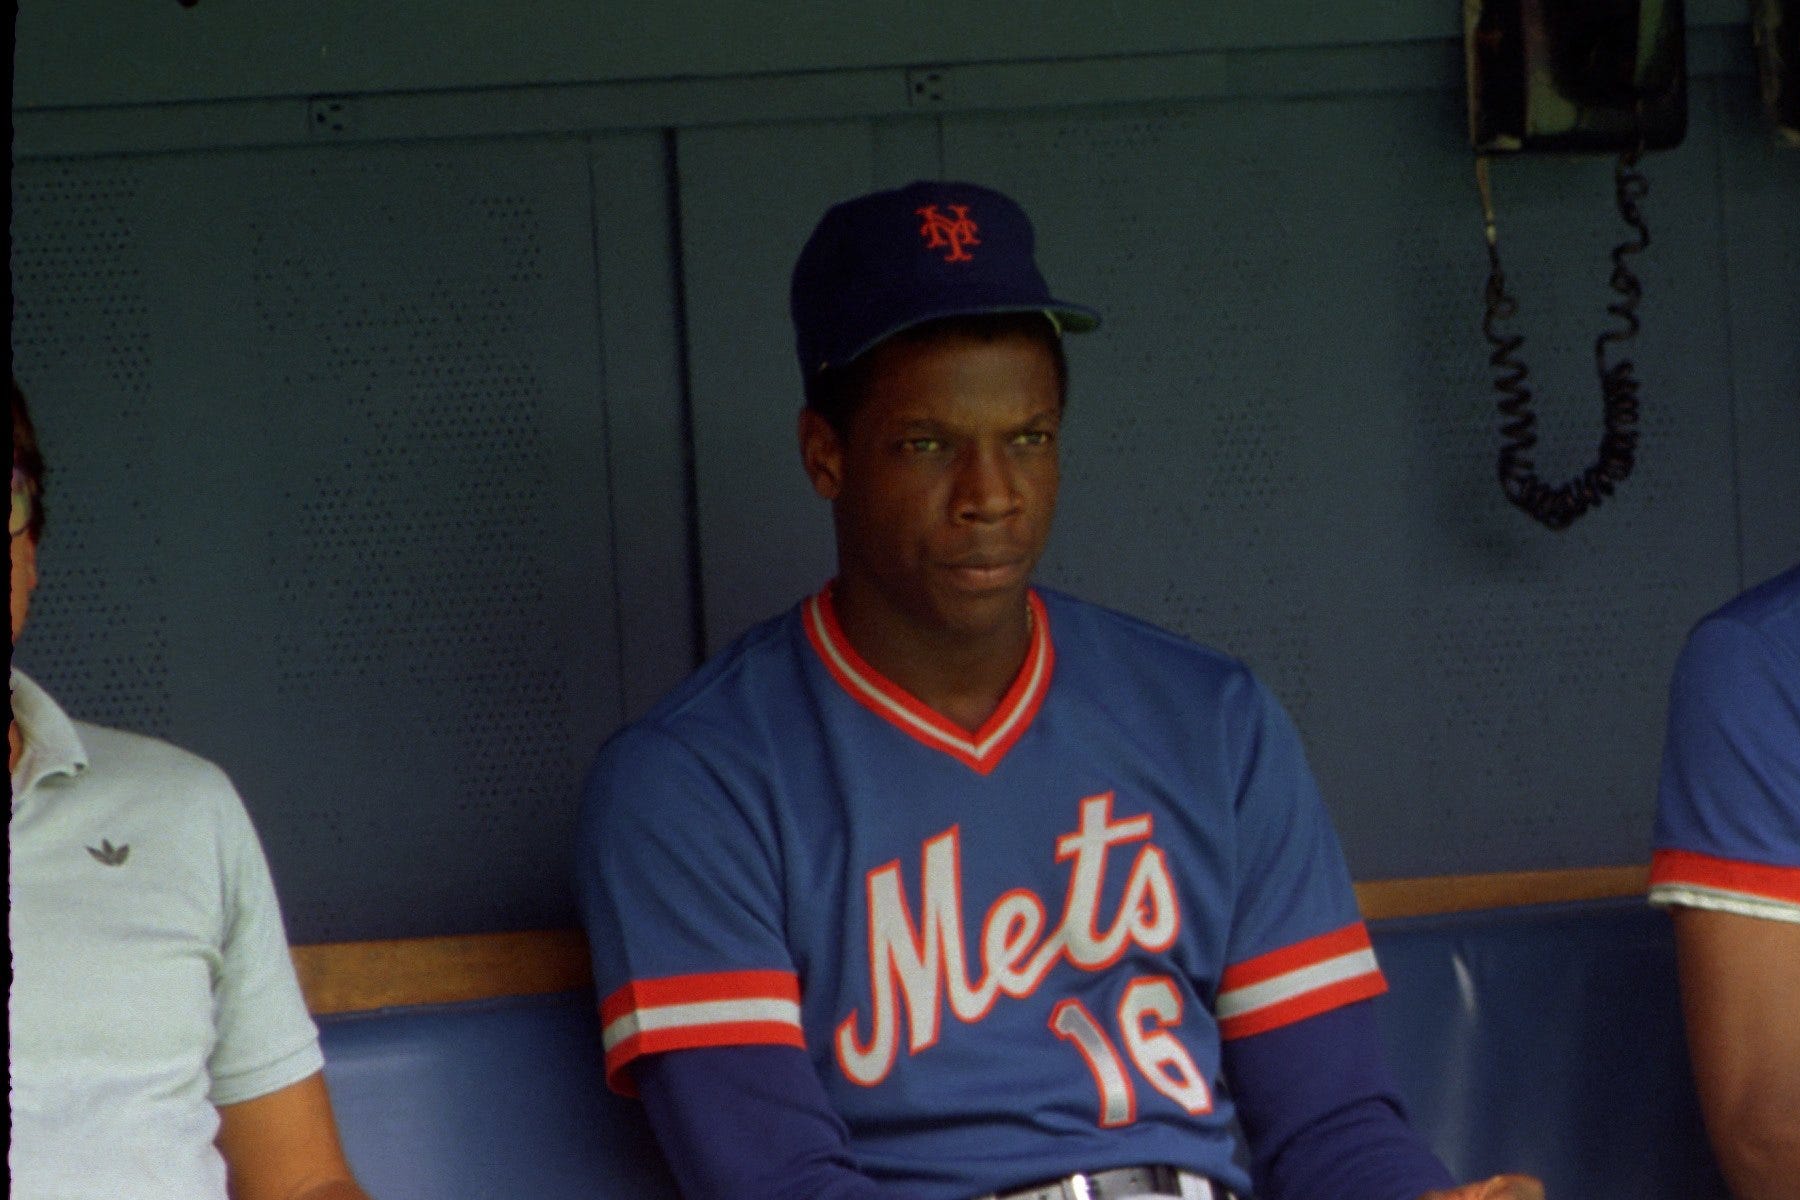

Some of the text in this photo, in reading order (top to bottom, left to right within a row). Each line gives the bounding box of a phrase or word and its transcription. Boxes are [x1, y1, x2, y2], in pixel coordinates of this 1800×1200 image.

[913, 204, 982, 263] NY
[834, 790, 1180, 1087] Mets
[1048, 974, 1214, 1128] 16
